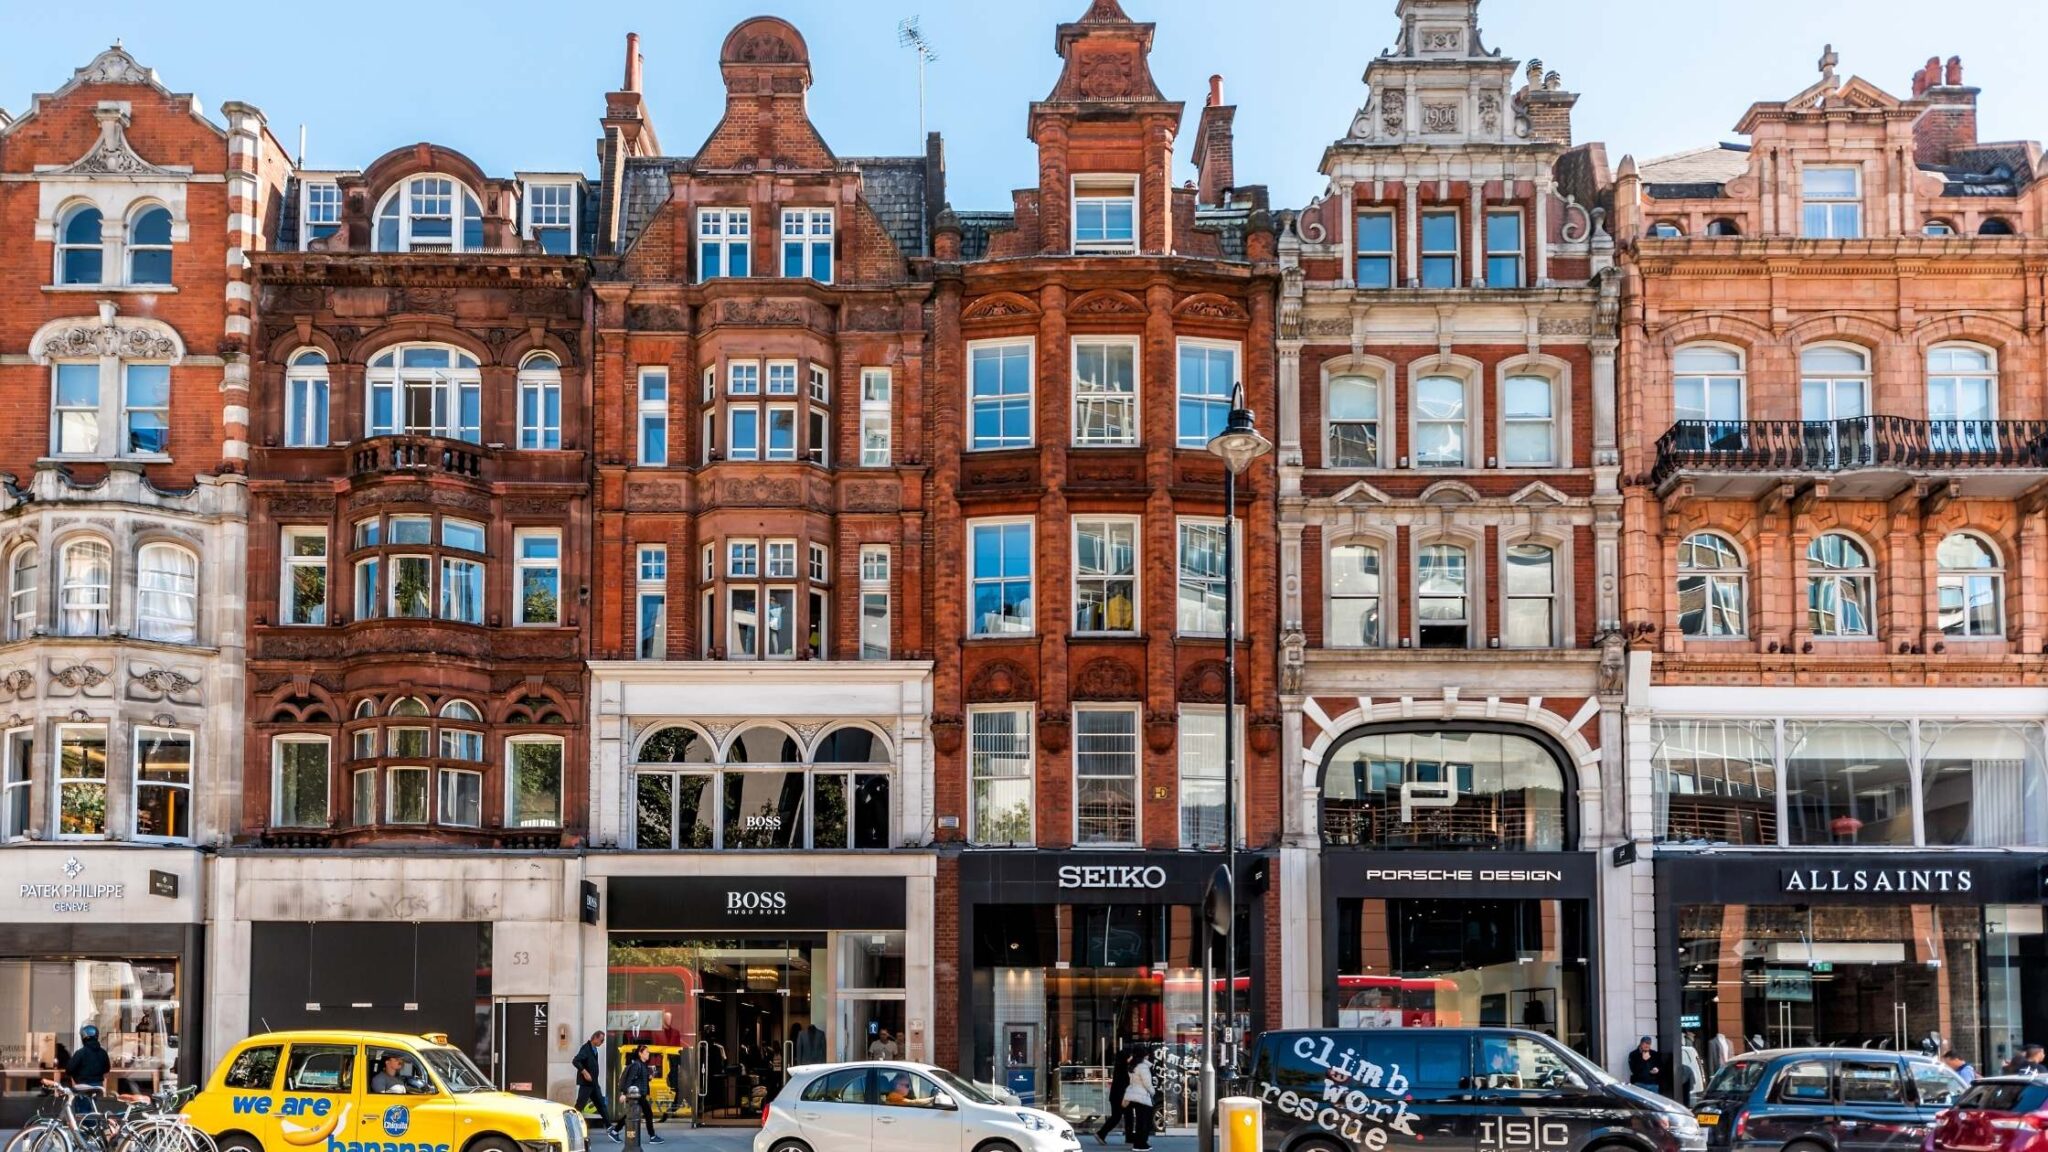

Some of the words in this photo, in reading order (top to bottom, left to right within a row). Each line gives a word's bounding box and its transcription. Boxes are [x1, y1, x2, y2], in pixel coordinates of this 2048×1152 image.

[1424, 107, 1456, 127] 1900
[746, 816, 781, 827] BOSS
[1058, 866, 1166, 889] SEIKO
[1366, 870, 1473, 881] PORSCHE
[1480, 870, 1562, 881] DESIGN
[1786, 870, 1972, 891] ALLSAINTS
[20, 884, 61, 899] PATEK
[64, 884, 123, 899] PHILIPPE
[53, 902, 90, 912] GENEVE
[727, 892, 786, 909] BOSS
[513, 952, 530, 966] 53
[535, 1004, 546, 1018] K
[233, 1096, 272, 1115] we
[281, 1096, 331, 1116] are
